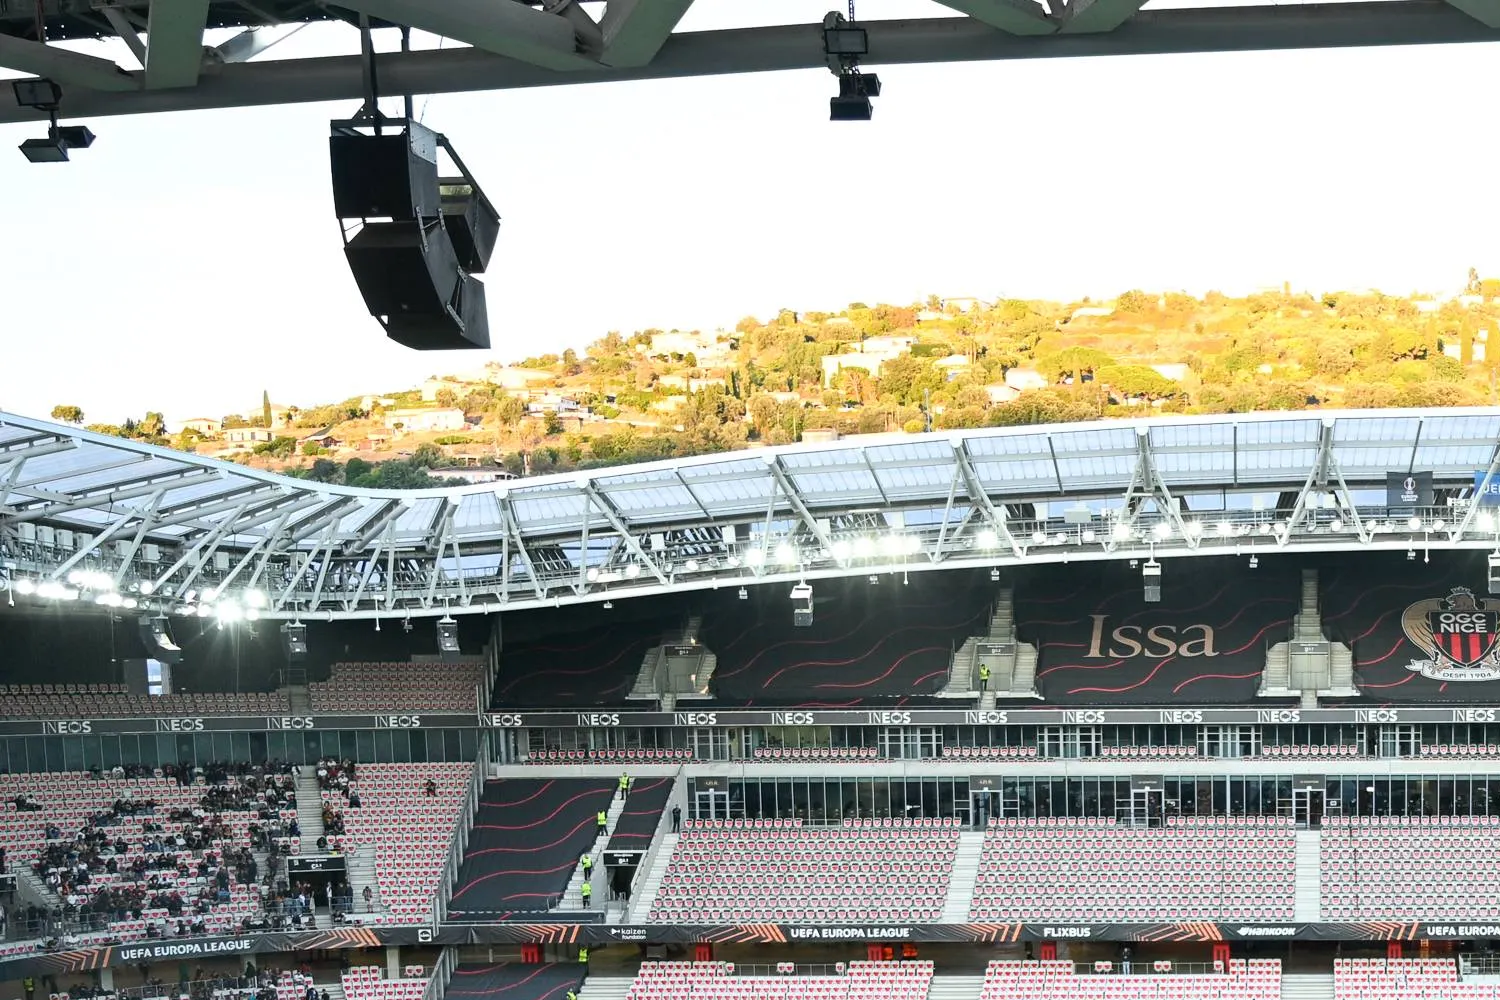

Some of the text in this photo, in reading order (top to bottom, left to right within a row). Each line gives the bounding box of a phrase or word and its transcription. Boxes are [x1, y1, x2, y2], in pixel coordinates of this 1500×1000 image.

[1440, 613, 1486, 624] OGC
[1441, 623, 1487, 633] NICE
[1084, 614, 1218, 658] Issa
[376, 715, 420, 728] INEOS
[578, 713, 619, 725] INEOS
[675, 713, 716, 725] INEOS
[771, 712, 813, 725] INEOS
[869, 712, 911, 725] INEOS
[966, 711, 1007, 724] INEOS
[1063, 711, 1105, 724] INEOS
[1160, 711, 1202, 724] INEOS
[1257, 710, 1300, 723] INEOS
[1355, 710, 1398, 723] INEOS
[1452, 708, 1495, 722] INEOS
[43, 720, 91, 734] INEOS
[156, 718, 204, 731] INEOS
[267, 717, 313, 729] INEOS
[621, 928, 647, 936] kaizen
[791, 928, 818, 938] UEFA
[822, 928, 864, 938] EUROPA
[1427, 926, 1456, 936] UEFA
[1458, 926, 1500, 936] EUROPA
[121, 947, 150, 960] UEFA
[154, 944, 201, 957] EUROPA
